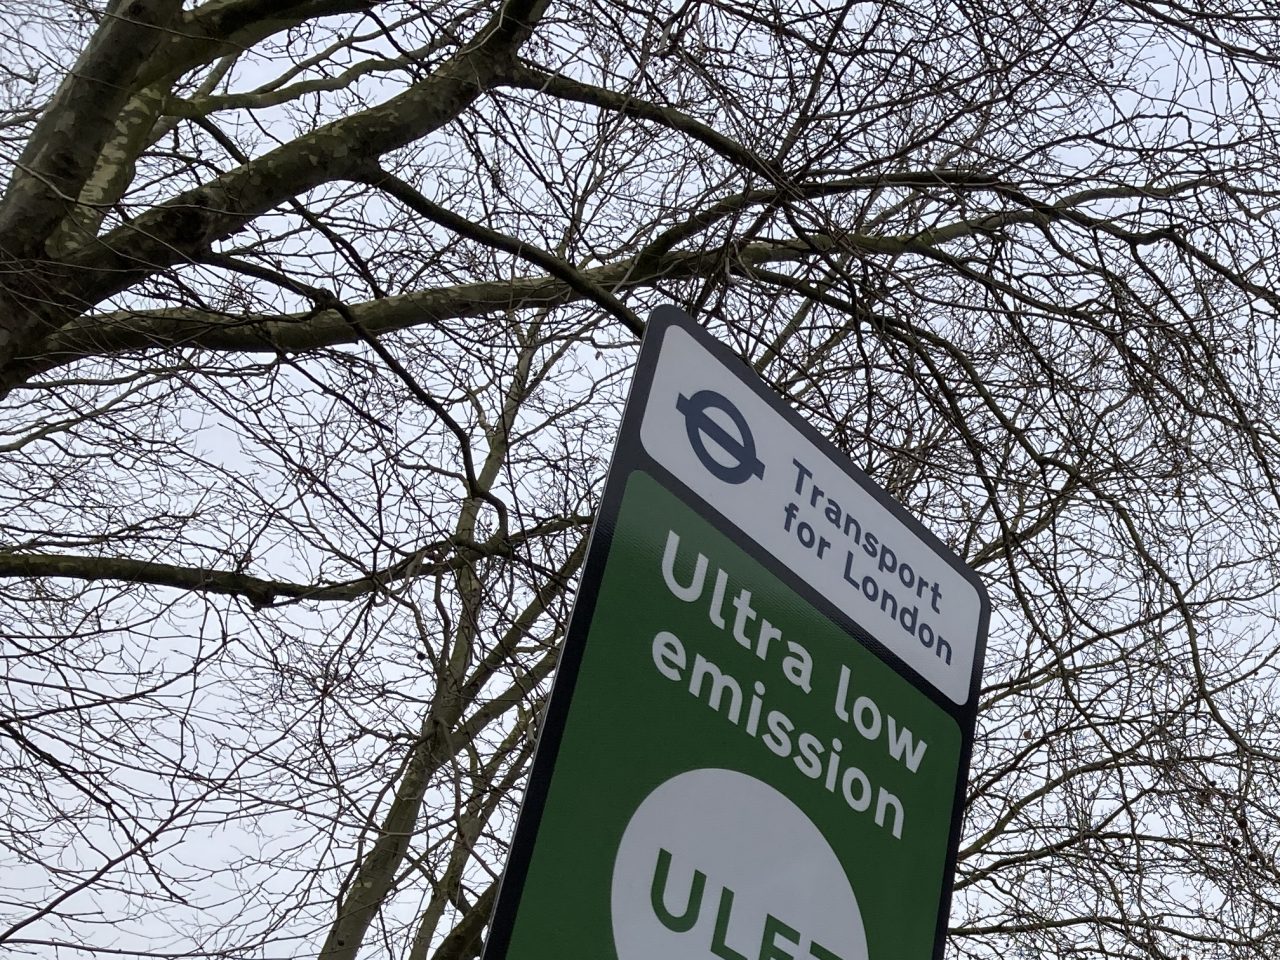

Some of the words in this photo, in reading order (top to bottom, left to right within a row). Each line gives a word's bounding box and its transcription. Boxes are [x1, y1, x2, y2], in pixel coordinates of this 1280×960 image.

[783, 502, 832, 560] for
[843, 550, 953, 666] London
[792, 457, 943, 615] Transport
[651, 631, 905, 840] emission
[661, 529, 813, 695] Ultra
[834, 664, 928, 774] low
